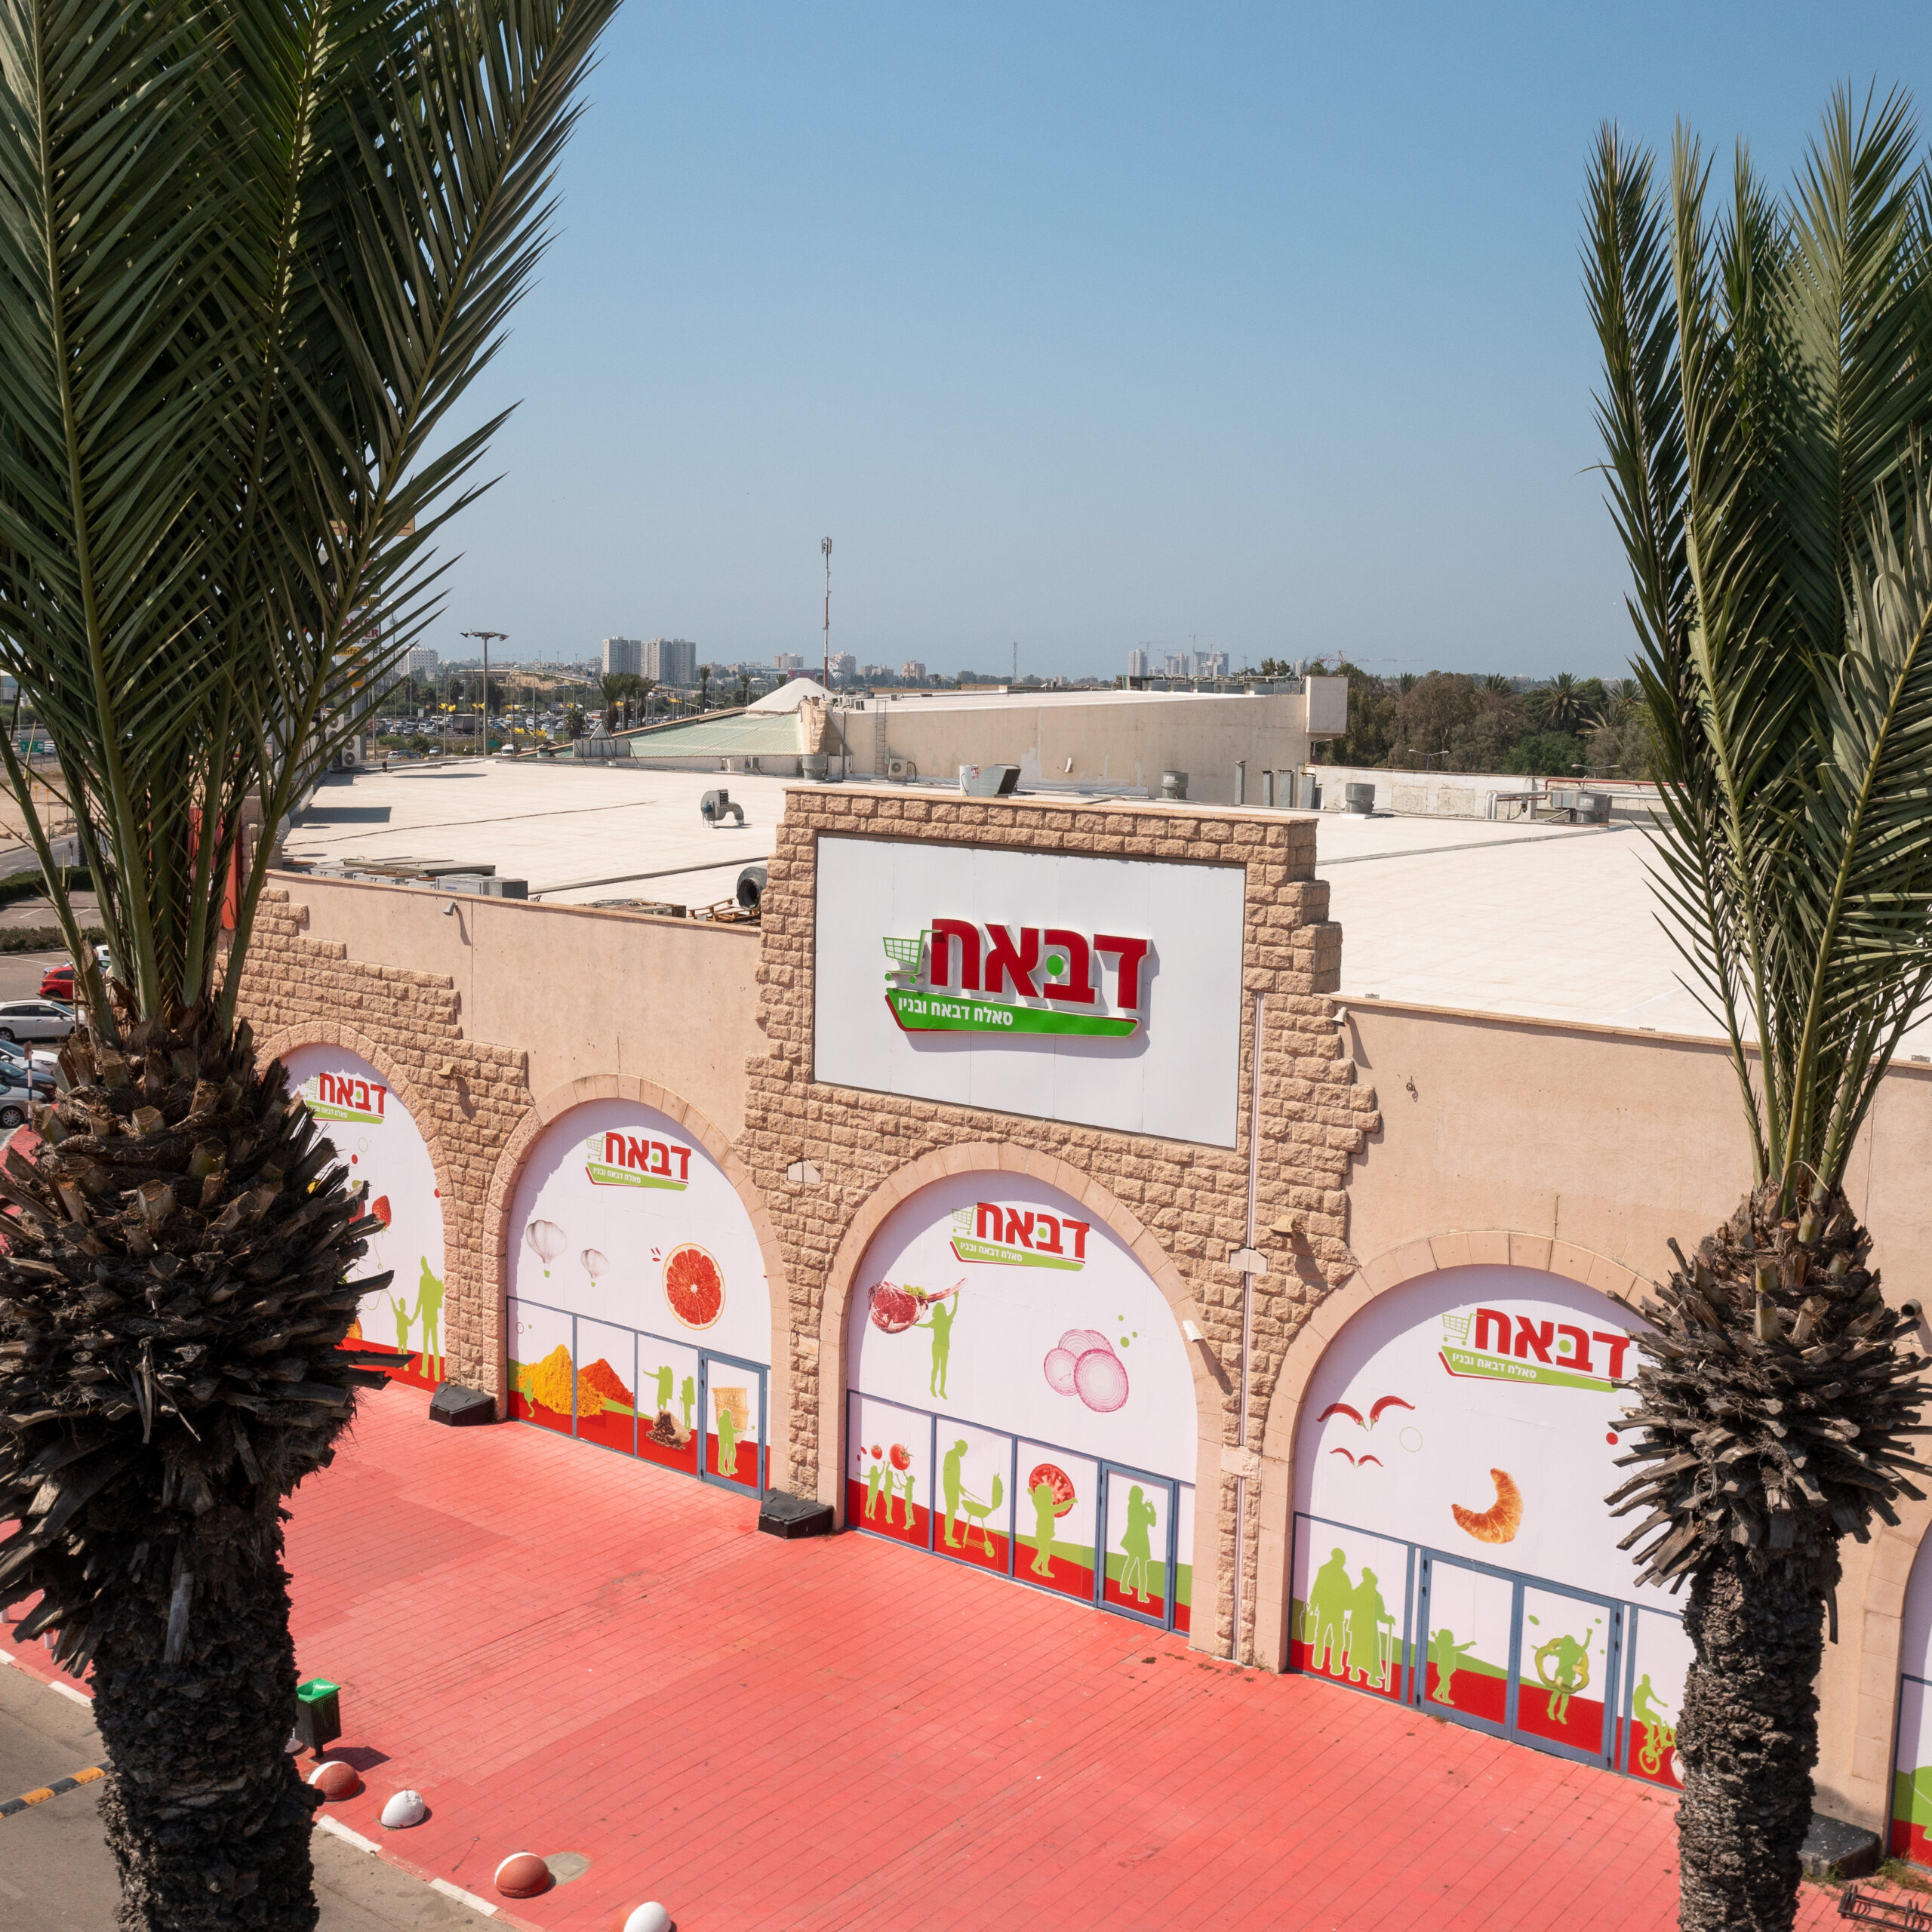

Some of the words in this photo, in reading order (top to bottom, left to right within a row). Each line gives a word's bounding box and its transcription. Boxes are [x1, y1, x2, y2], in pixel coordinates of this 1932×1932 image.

[931, 918, 1147, 1009] דבאח
[931, 1002, 971, 1020] דבאח
[974, 1007, 1014, 1026] סאלח
[319, 1072, 387, 1115] דבאח
[605, 1131, 691, 1180] דבאח
[607, 1170, 624, 1180] דבאח
[624, 1174, 641, 1184] סאלח
[977, 1201, 1090, 1259] דבאח
[978, 1245, 999, 1257] דבאח
[1001, 1249, 1023, 1263] סאלח
[1475, 1308, 1630, 1379] דבאח
[1477, 1358, 1506, 1373] דבאח
[1508, 1364, 1537, 1380] סאלח
